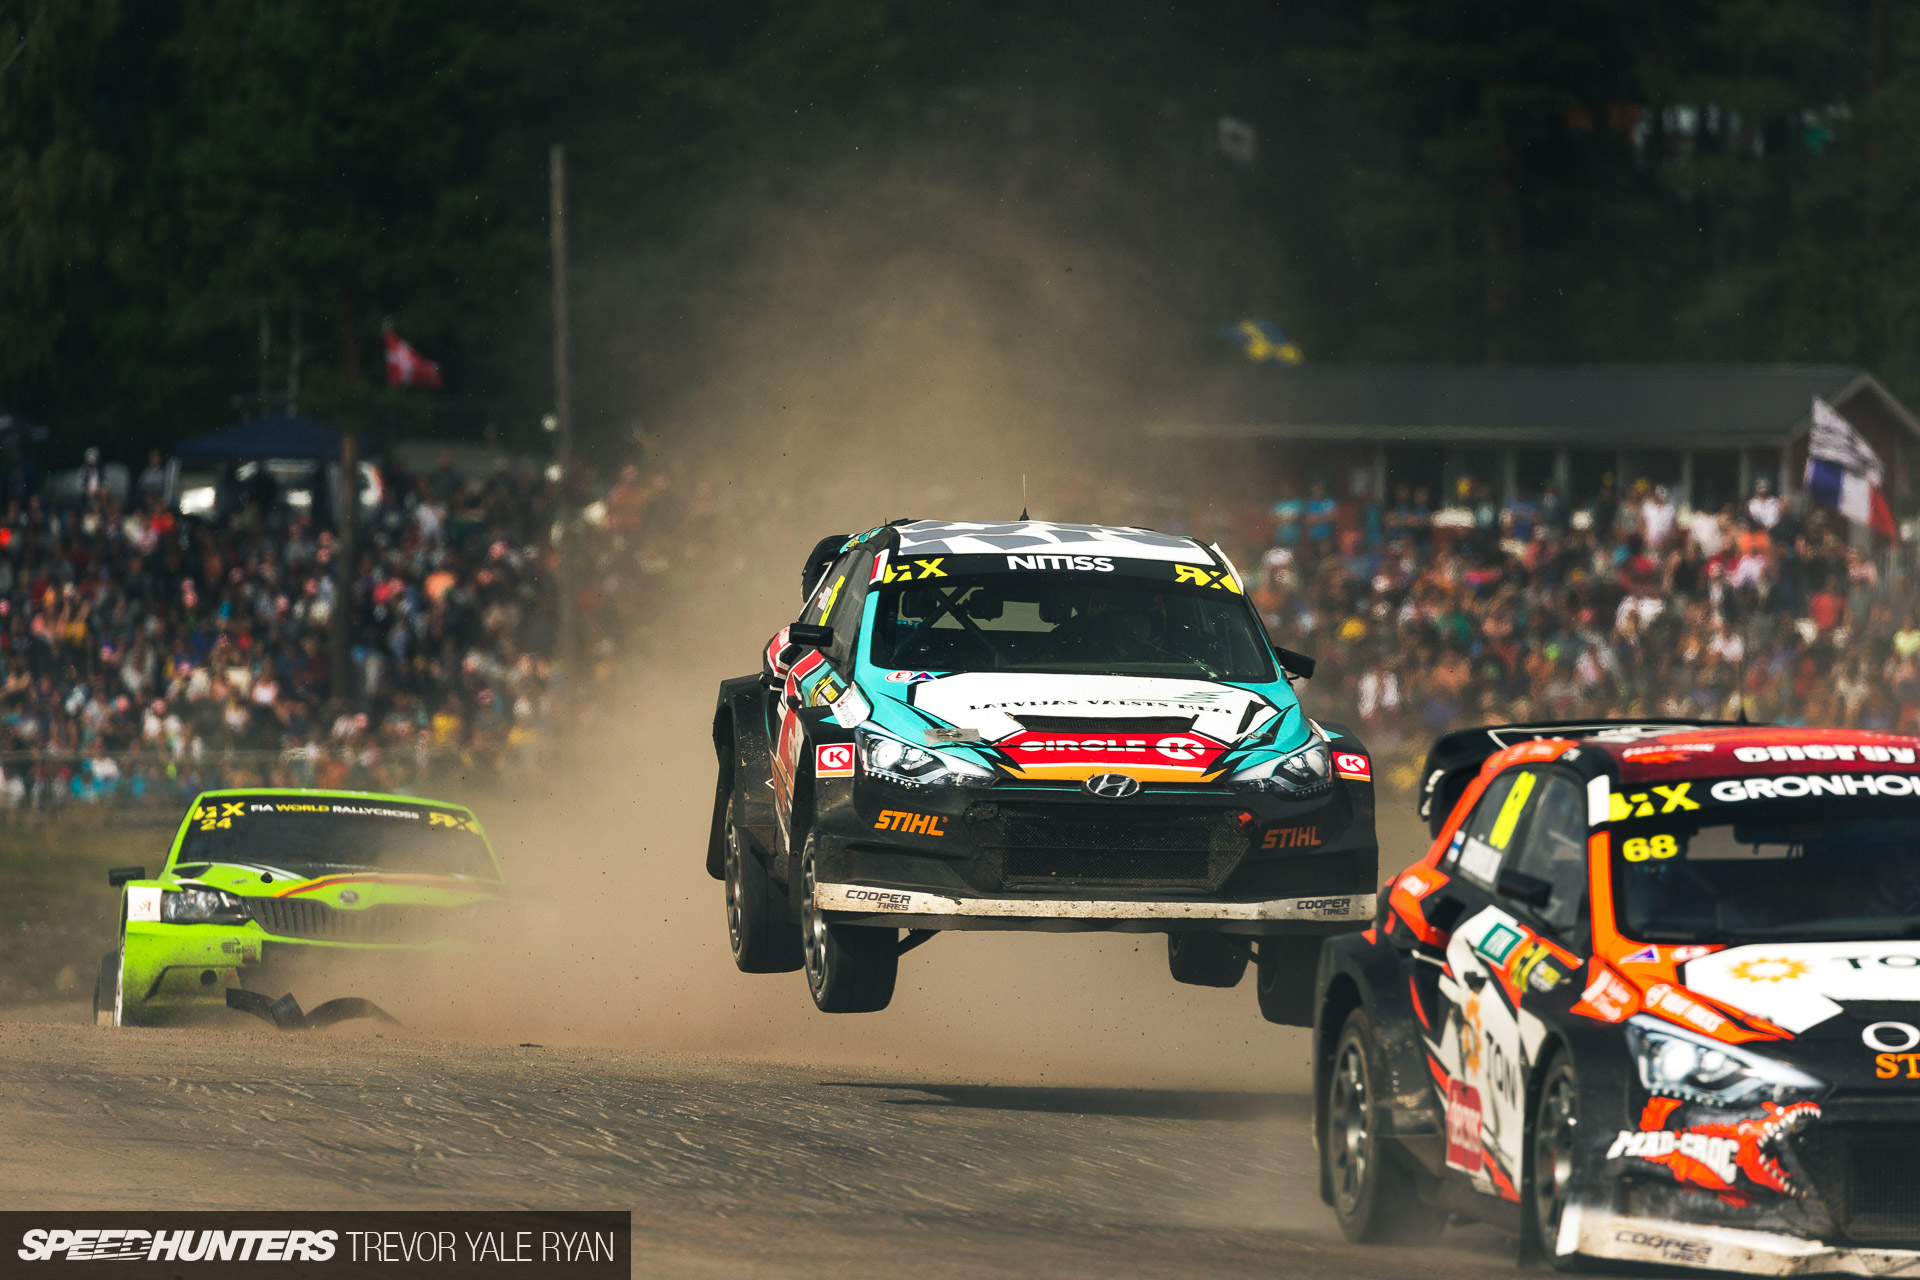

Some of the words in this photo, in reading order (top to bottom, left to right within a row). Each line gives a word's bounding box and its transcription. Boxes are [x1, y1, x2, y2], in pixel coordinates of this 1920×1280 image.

[1007, 555, 1114, 573] NITISS
[1018, 739, 1147, 753] CIRCLE
[1162, 739, 1203, 759] K
[250, 803, 274, 813] FIA
[275, 803, 330, 813] WORLD
[332, 805, 420, 820] RALLYCROSS
[200, 817, 232, 831] 24
[874, 809, 945, 837] STIHL
[1260, 825, 1322, 849] STIHL
[1622, 834, 1679, 862] 68
[845, 889, 912, 905] COOPER
[1296, 898, 1351, 910] COOPER
[877, 901, 910, 911] TIRES
[1322, 907, 1350, 916] TIRES
